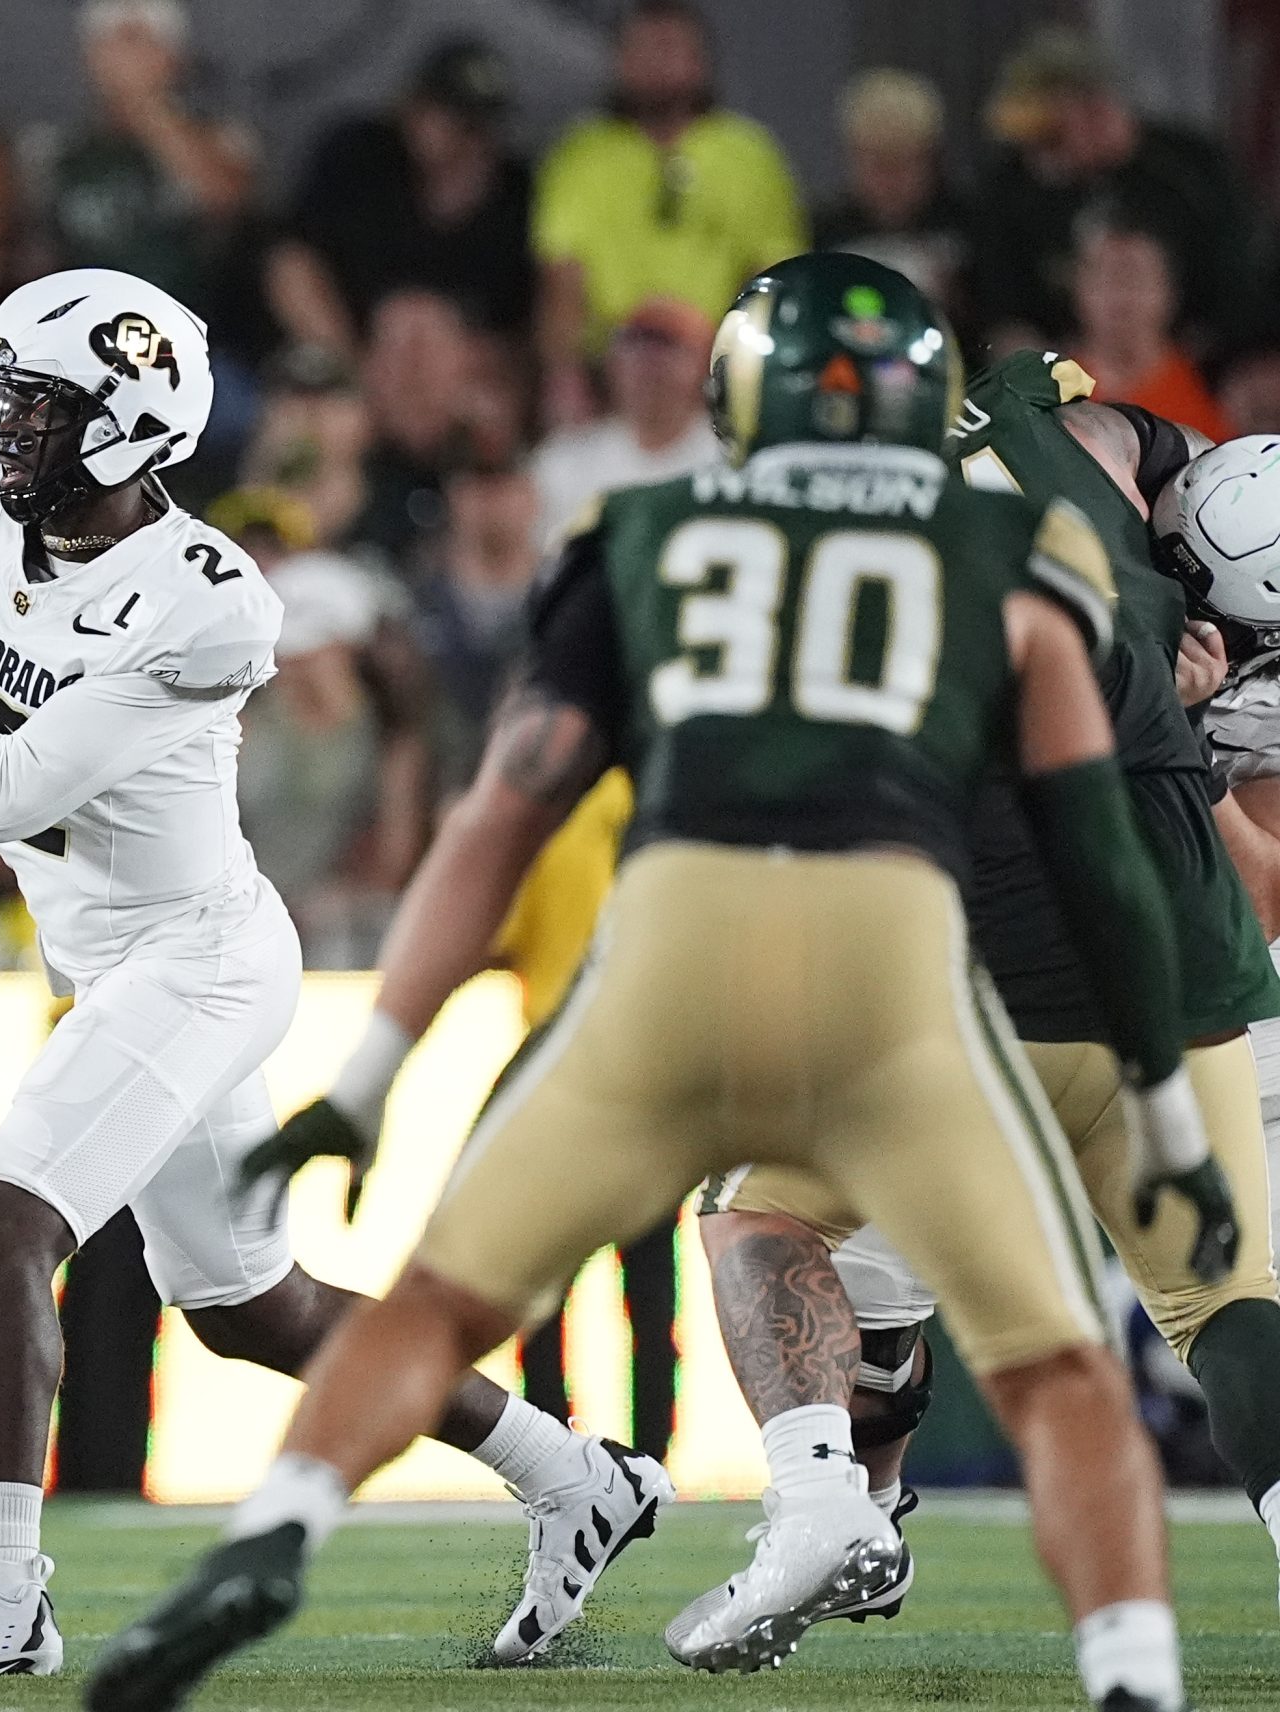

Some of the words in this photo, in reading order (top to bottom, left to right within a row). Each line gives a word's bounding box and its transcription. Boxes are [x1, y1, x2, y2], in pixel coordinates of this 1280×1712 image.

[116, 318, 162, 367] CU
[183, 543, 243, 586] 2
[14, 591, 30, 616] CU
[113, 592, 141, 630] L
[650, 515, 946, 735] 30
